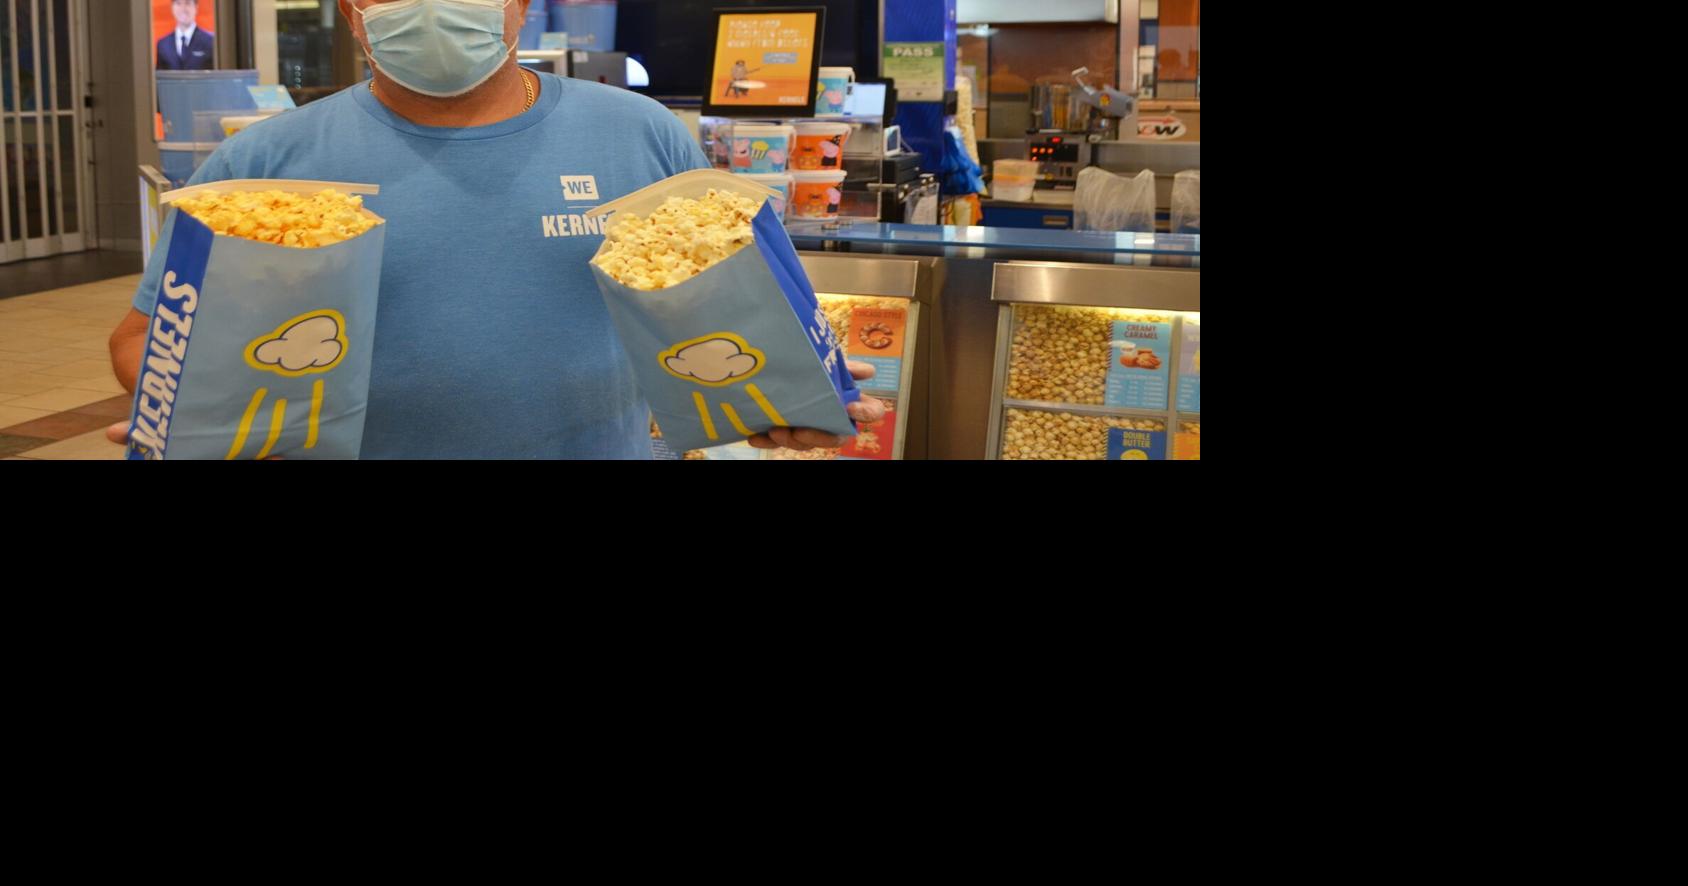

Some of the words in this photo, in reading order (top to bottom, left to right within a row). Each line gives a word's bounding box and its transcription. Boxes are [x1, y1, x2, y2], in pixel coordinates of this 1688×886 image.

[893, 47, 934, 57] PASS
[567, 181, 593, 194] WE
[1126, 324, 1157, 332] CREAMY
[1123, 331, 1158, 339] CARAMEL
[131, 270, 198, 460] KERNELS
[1123, 431, 1151, 440] DOUBLE
[1122, 439, 1151, 448] BUTTER
